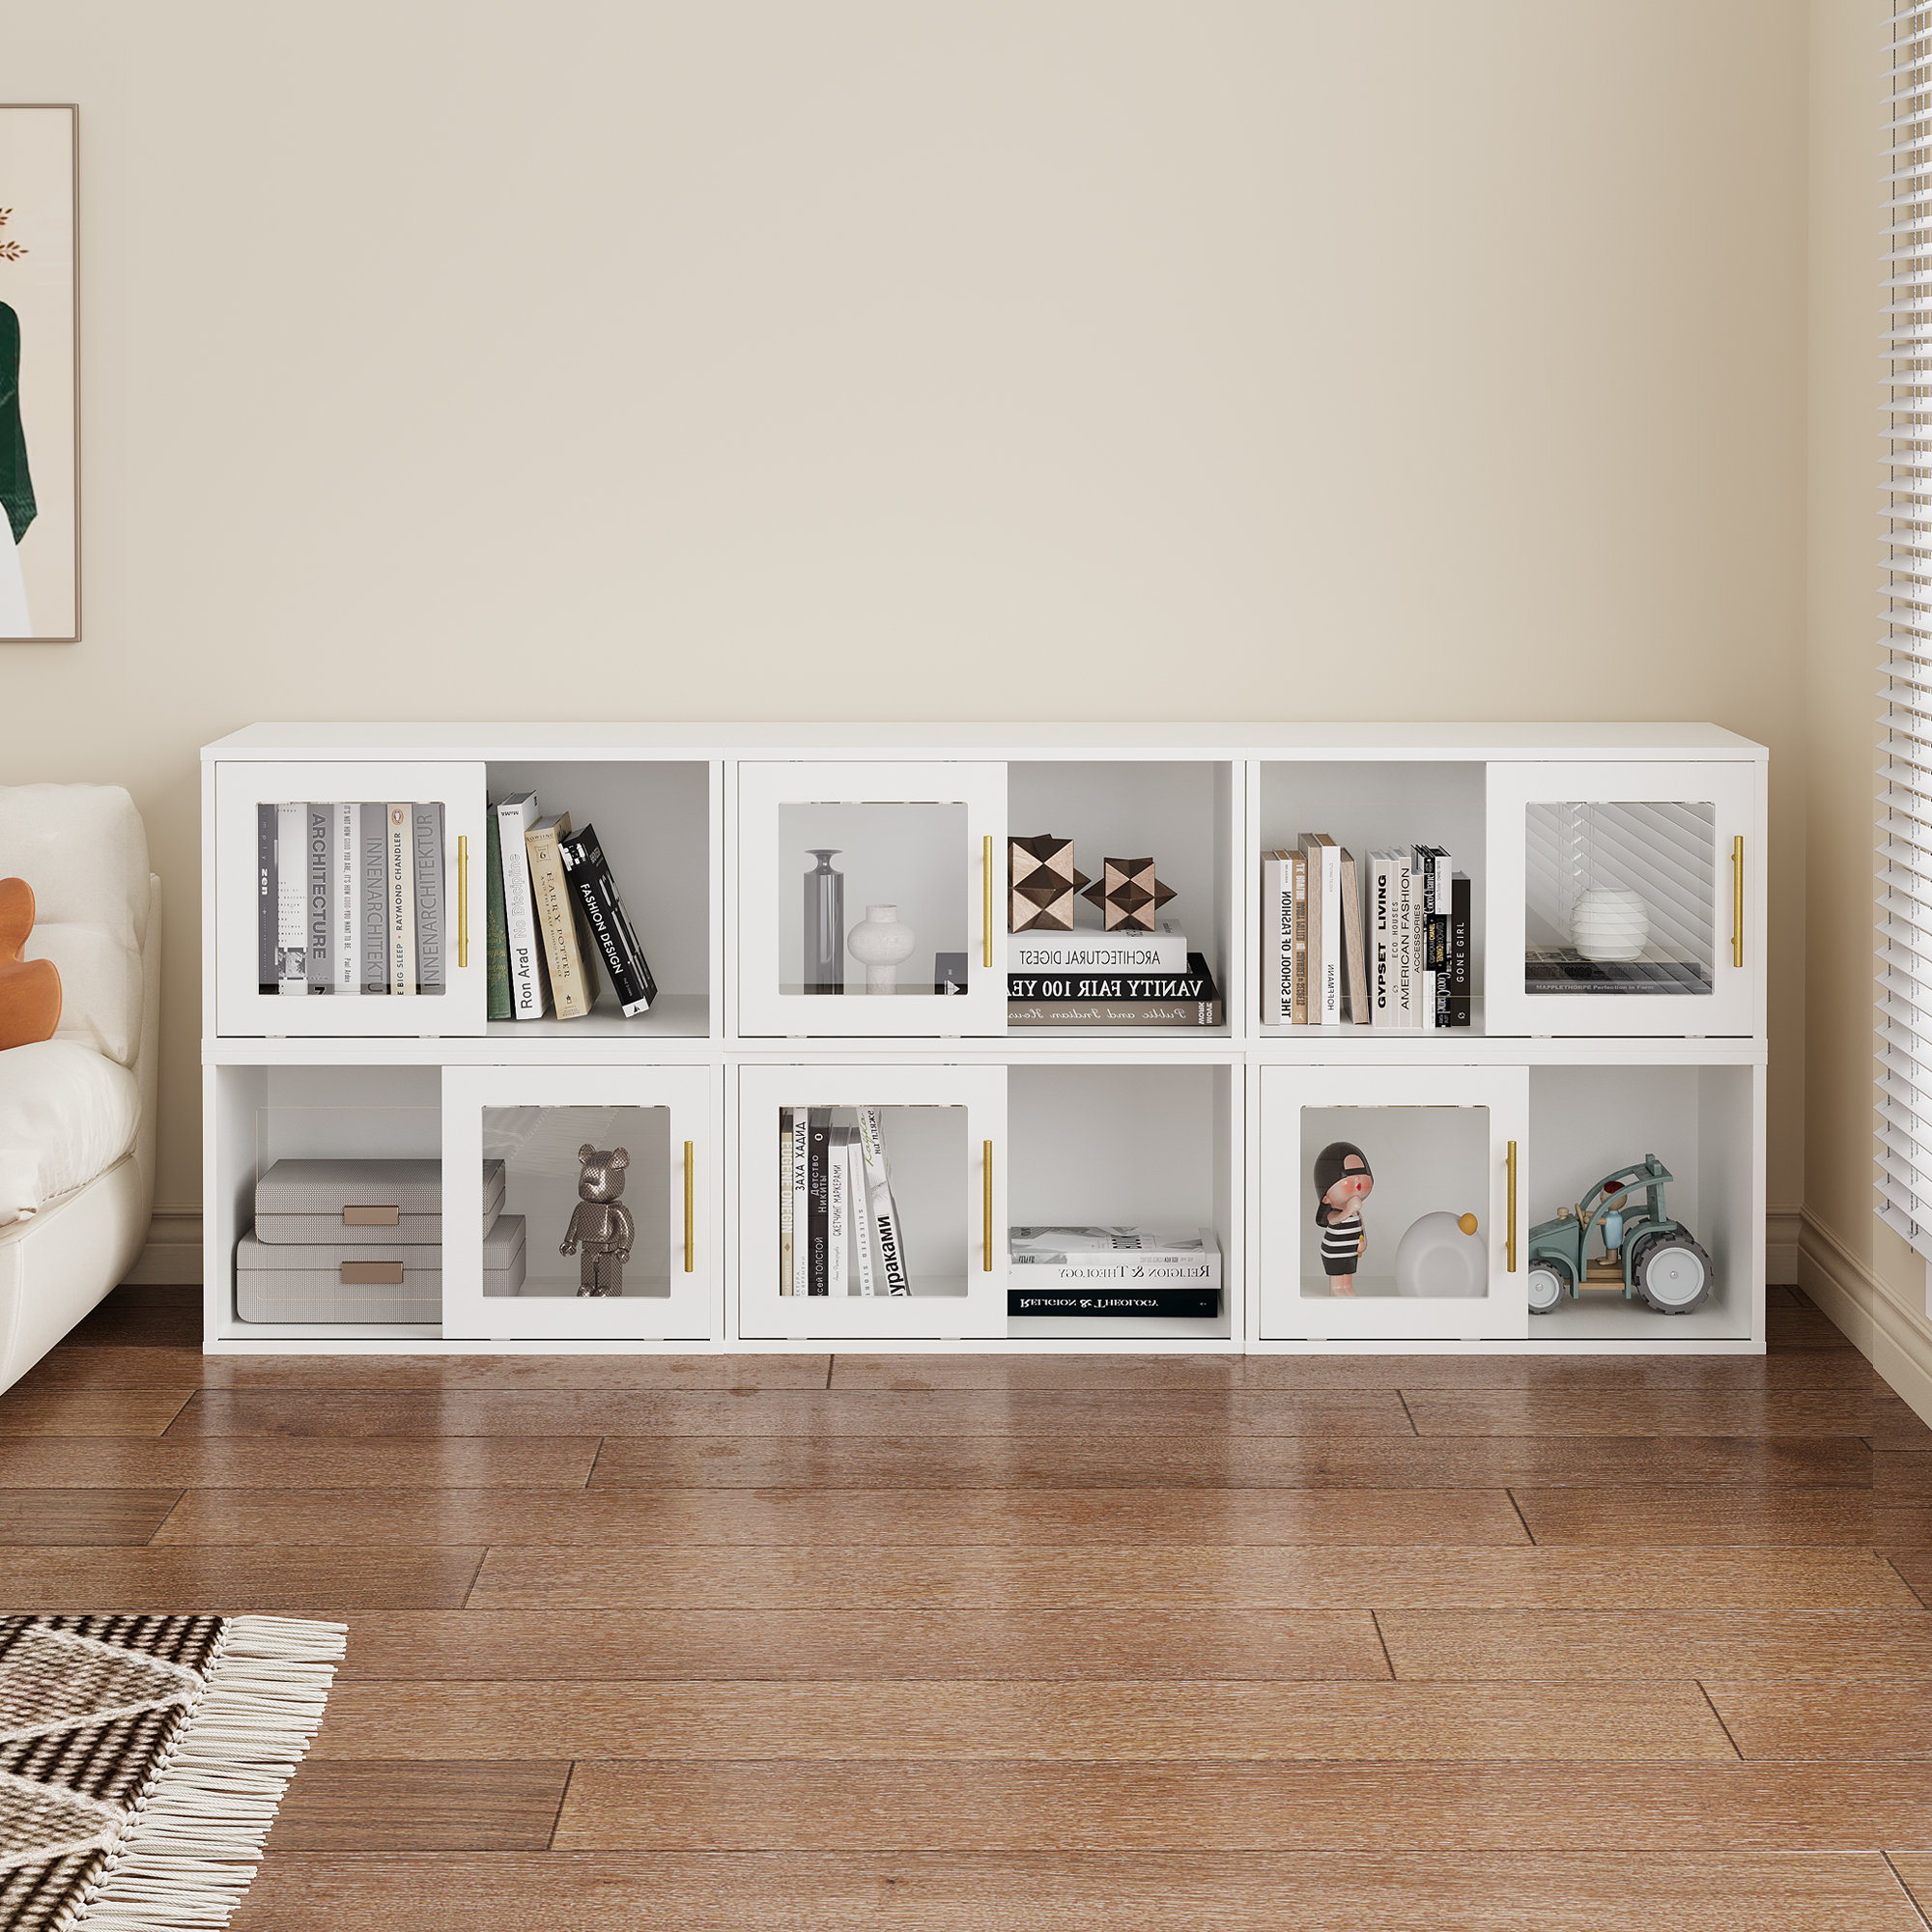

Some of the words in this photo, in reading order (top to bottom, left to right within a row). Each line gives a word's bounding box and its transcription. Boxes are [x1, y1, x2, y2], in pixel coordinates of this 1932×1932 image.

[312, 813, 327, 958] ARCHITECTURE
[416, 813, 440, 987] INNENARCHITEKTUR
[509, 854, 525, 916] Discipline
[1378, 874, 1386, 930] LIVING
[1401, 867, 1409, 929] FASHION
[367, 838, 384, 992] INNENARCHITEKTU
[514, 920, 526, 939] No
[547, 871, 561, 923] HARRY
[557, 929, 571, 978] POTTER
[580, 883, 607, 932] FASHION
[600, 932, 624, 975] DESIGN
[1456, 922, 1464, 947] GIRL
[516, 948, 530, 978] Arad
[1378, 942, 1386, 1009] GYPSET
[1401, 934, 1409, 1010] AMERICAN
[1456, 952, 1464, 982] GONE
[521, 982, 533, 1009] Ron
[795, 1122, 807, 1159] ХАДИД
[867, 1110, 879, 1140] пляже
[781, 1141, 792, 1187] EUGENE
[873, 1144, 881, 1155] на
[795, 1164, 806, 1191] ЗАХА
[810, 1154, 819, 1197] Детство
[818, 1175, 828, 1213] Никиты
[833, 1164, 841, 1204] МАРКЕРАМИ
[781, 1190, 792, 1234] ONEGIN
[833, 1204, 841, 1237] СКЕТЧИНГ
[858, 1208, 867, 1259] SELECTED
[814, 1236, 824, 1272] ТОЛСТОЙ
[877, 1216, 906, 1296] ураками
